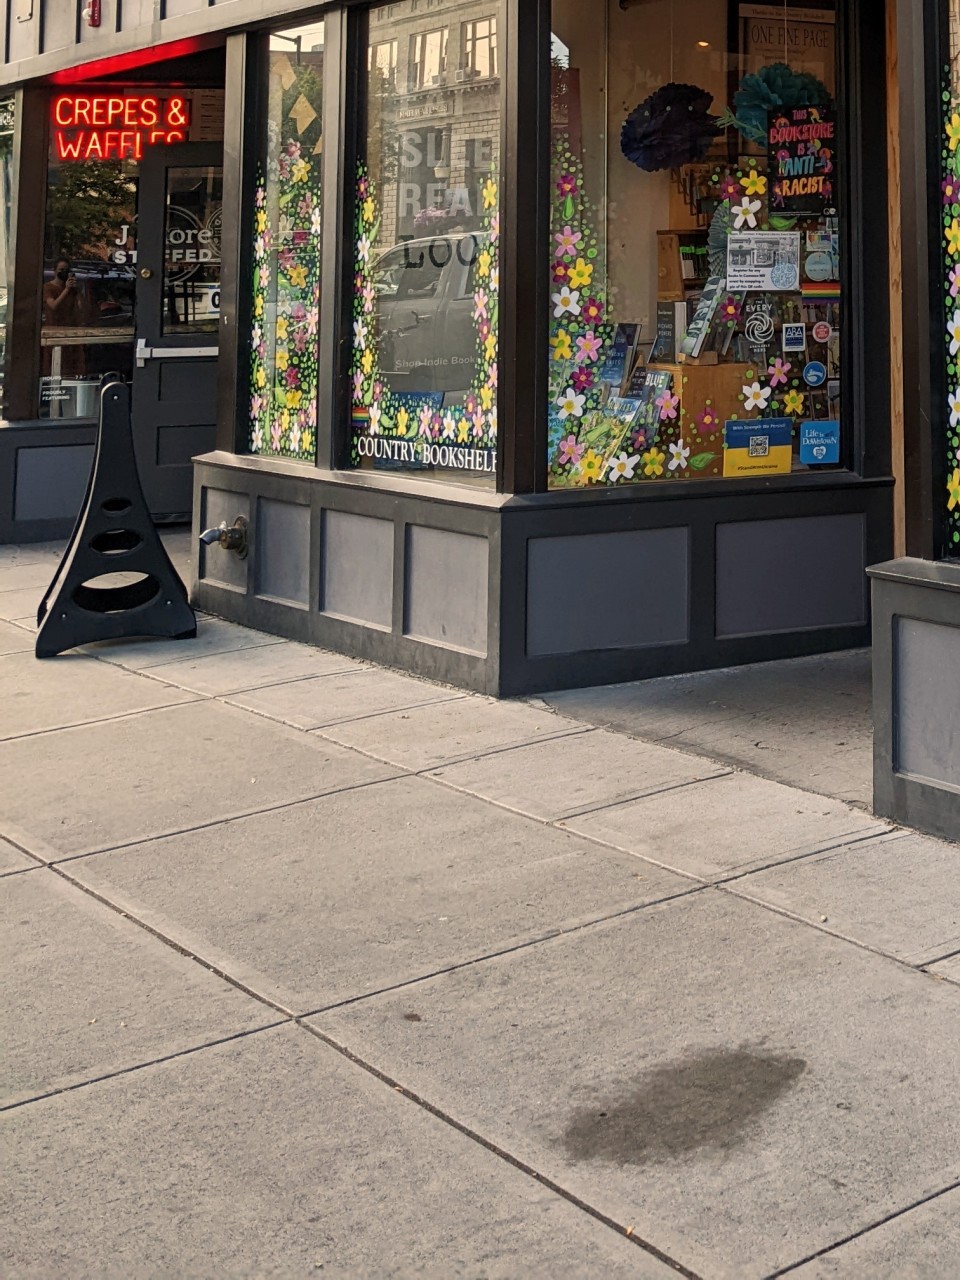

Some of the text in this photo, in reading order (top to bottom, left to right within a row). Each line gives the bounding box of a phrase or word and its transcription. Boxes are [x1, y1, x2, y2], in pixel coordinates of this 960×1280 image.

[751, 25, 829, 48] ONE FINE PAGE
[55, 97, 157, 126] CREPES
[167, 98, 186, 126] &
[792, 110, 807, 120] THIS
[769, 122, 834, 144] BOOKSTORE
[797, 143, 805, 156] IS
[784, 155, 823, 176] ANTI-
[782, 176, 825, 196] RACIST
[114, 249, 213, 264] STFED
[745, 303, 773, 312] EVERY
[395, 360, 420, 370] Shop
[424, 358, 449, 367] Indie
[645, 373, 665, 388] BLUE
[805, 429, 819, 438] Life
[357, 436, 417, 462] COUNTRY
